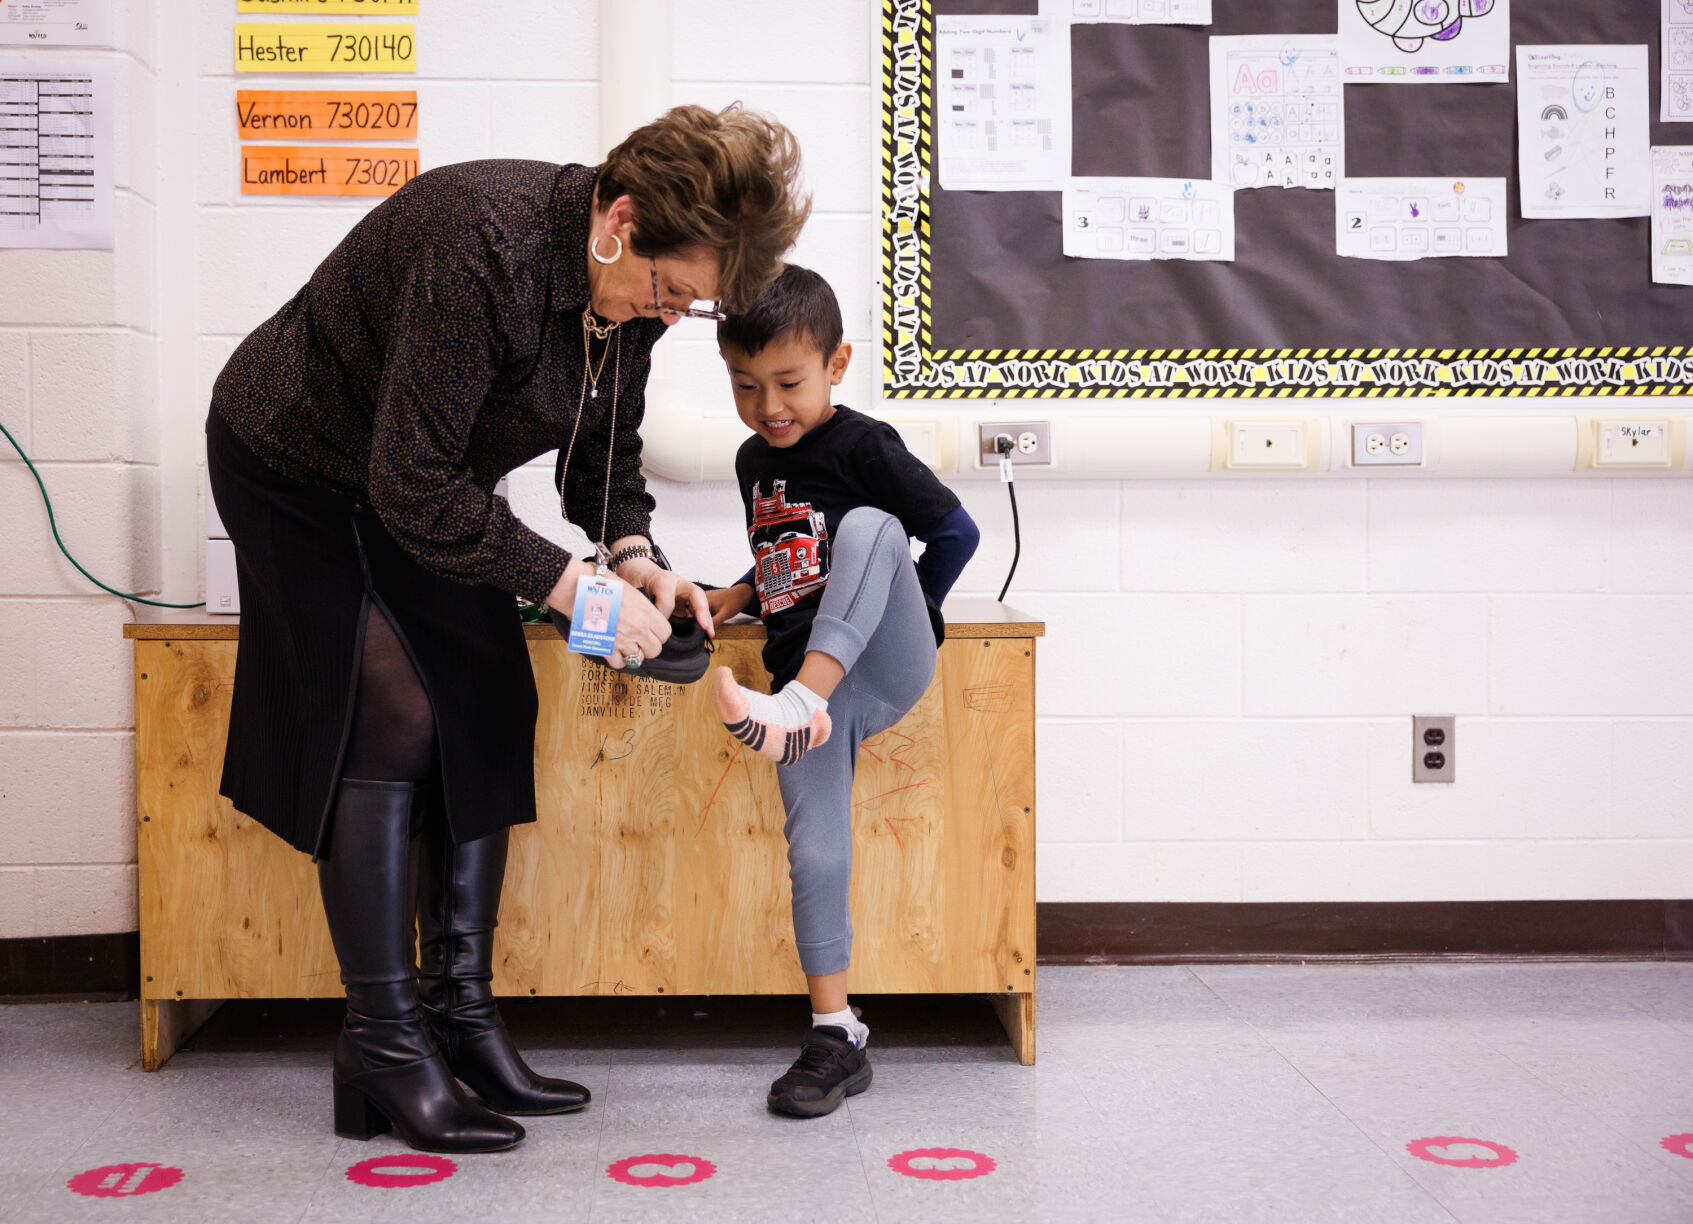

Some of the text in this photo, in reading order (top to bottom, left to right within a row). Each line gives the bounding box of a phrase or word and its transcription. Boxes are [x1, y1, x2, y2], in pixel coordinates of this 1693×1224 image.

[238, 34, 412, 62] Hester 730140
[893, 40, 922, 108] KIDS
[1232, 63, 1278, 94] Aa
[1605, 87, 1615, 99] B
[237, 101, 417, 129] Vernon 730207
[1605, 107, 1616, 119] C
[893, 110, 920, 146] AT
[1605, 128, 1615, 139] H
[1605, 147, 1615, 159] P
[244, 157, 327, 185] Lambert
[1605, 168, 1615, 179] F
[892, 151, 921, 222] WORK
[1605, 187, 1616, 199] R
[1076, 215, 1089, 228] 3
[1351, 217, 1363, 229] 2
[892, 231, 921, 297] KIDS
[893, 300, 921, 335] AT
[958, 361, 992, 387] AT
[998, 358, 1075, 388] WORK
[1076, 360, 1144, 388] KIDS
[1145, 361, 1178, 387] AT
[1183, 358, 1257, 387] WORK
[1265, 359, 1330, 387] KIDS
[1331, 359, 1364, 386] AT
[1369, 358, 1442, 387] WORK
[1450, 359, 1514, 388] KIDS
[1516, 359, 1549, 386] AT
[1555, 357, 1626, 386] WORK
[1631, 356, 1693, 385] KIDS
[772, 563, 778, 573] 5
[770, 595, 793, 609] RESCUE
